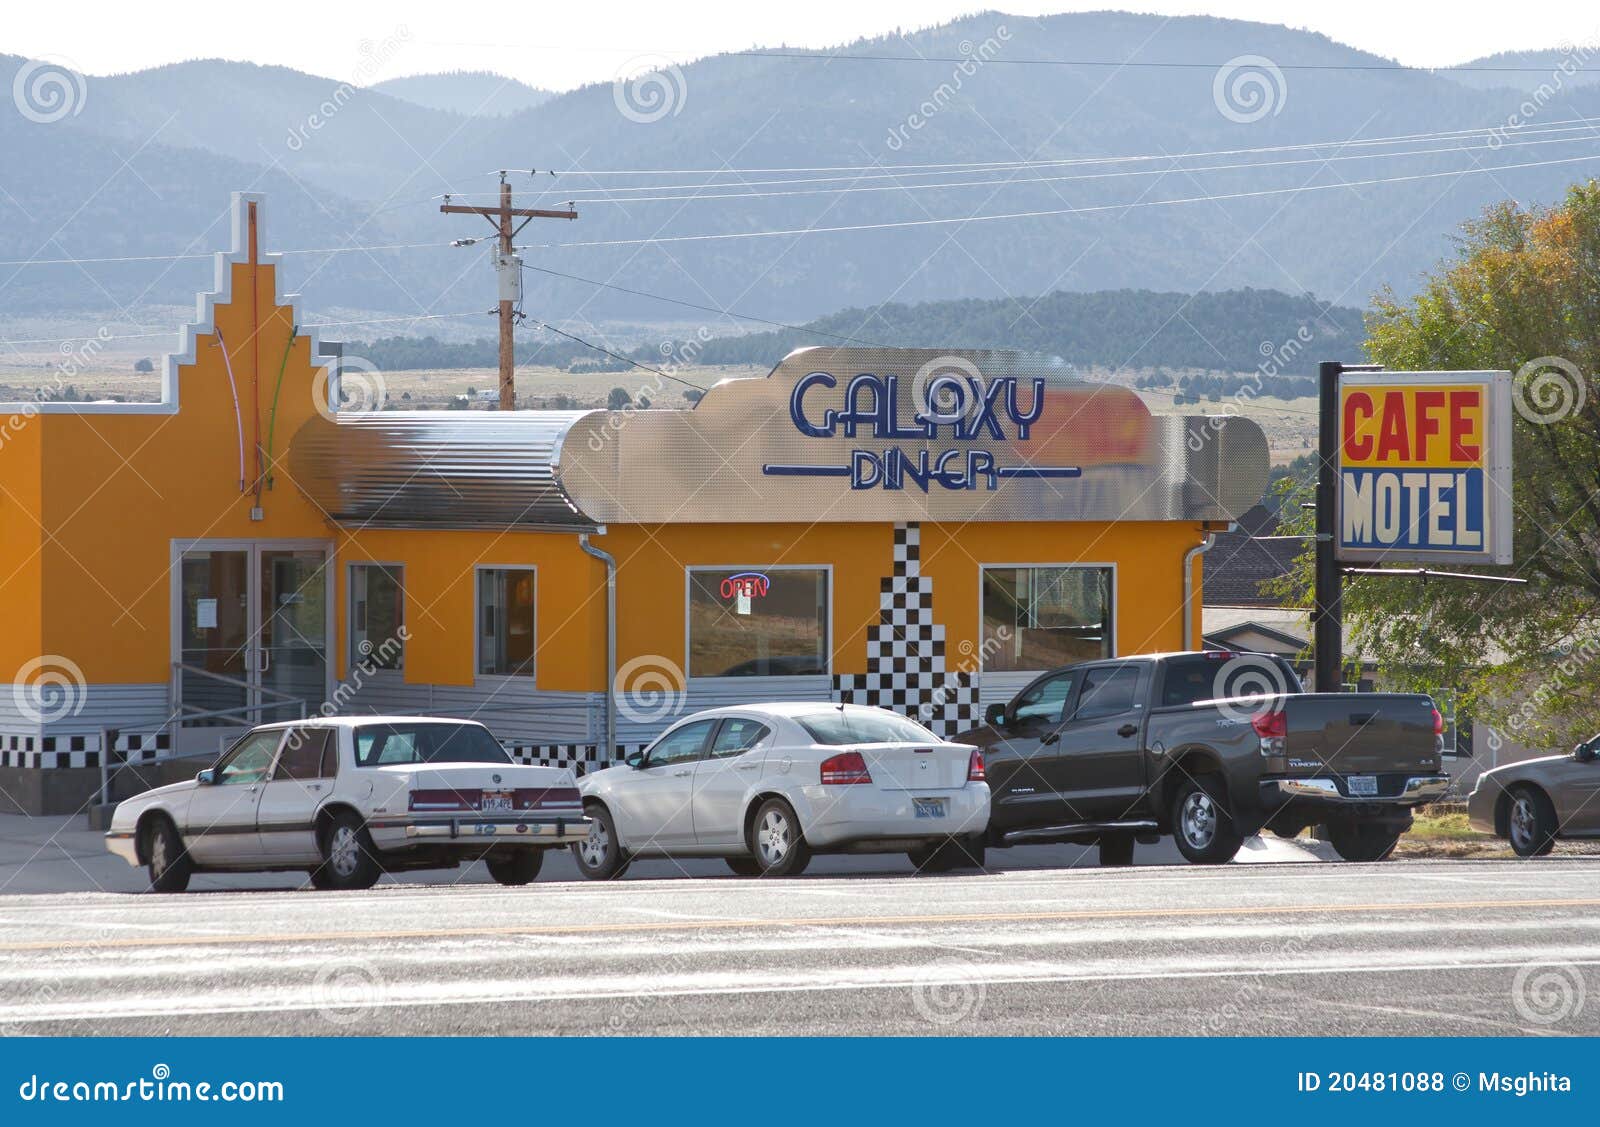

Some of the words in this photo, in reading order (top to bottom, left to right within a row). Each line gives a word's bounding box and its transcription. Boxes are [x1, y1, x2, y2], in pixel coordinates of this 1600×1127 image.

[790, 371, 1044, 440] GALAXY
[1343, 391, 1480, 462] CAFE
[851, 446, 998, 493] DINER
[1343, 472, 1481, 546] MOTEL
[720, 578, 767, 599] OPEN
